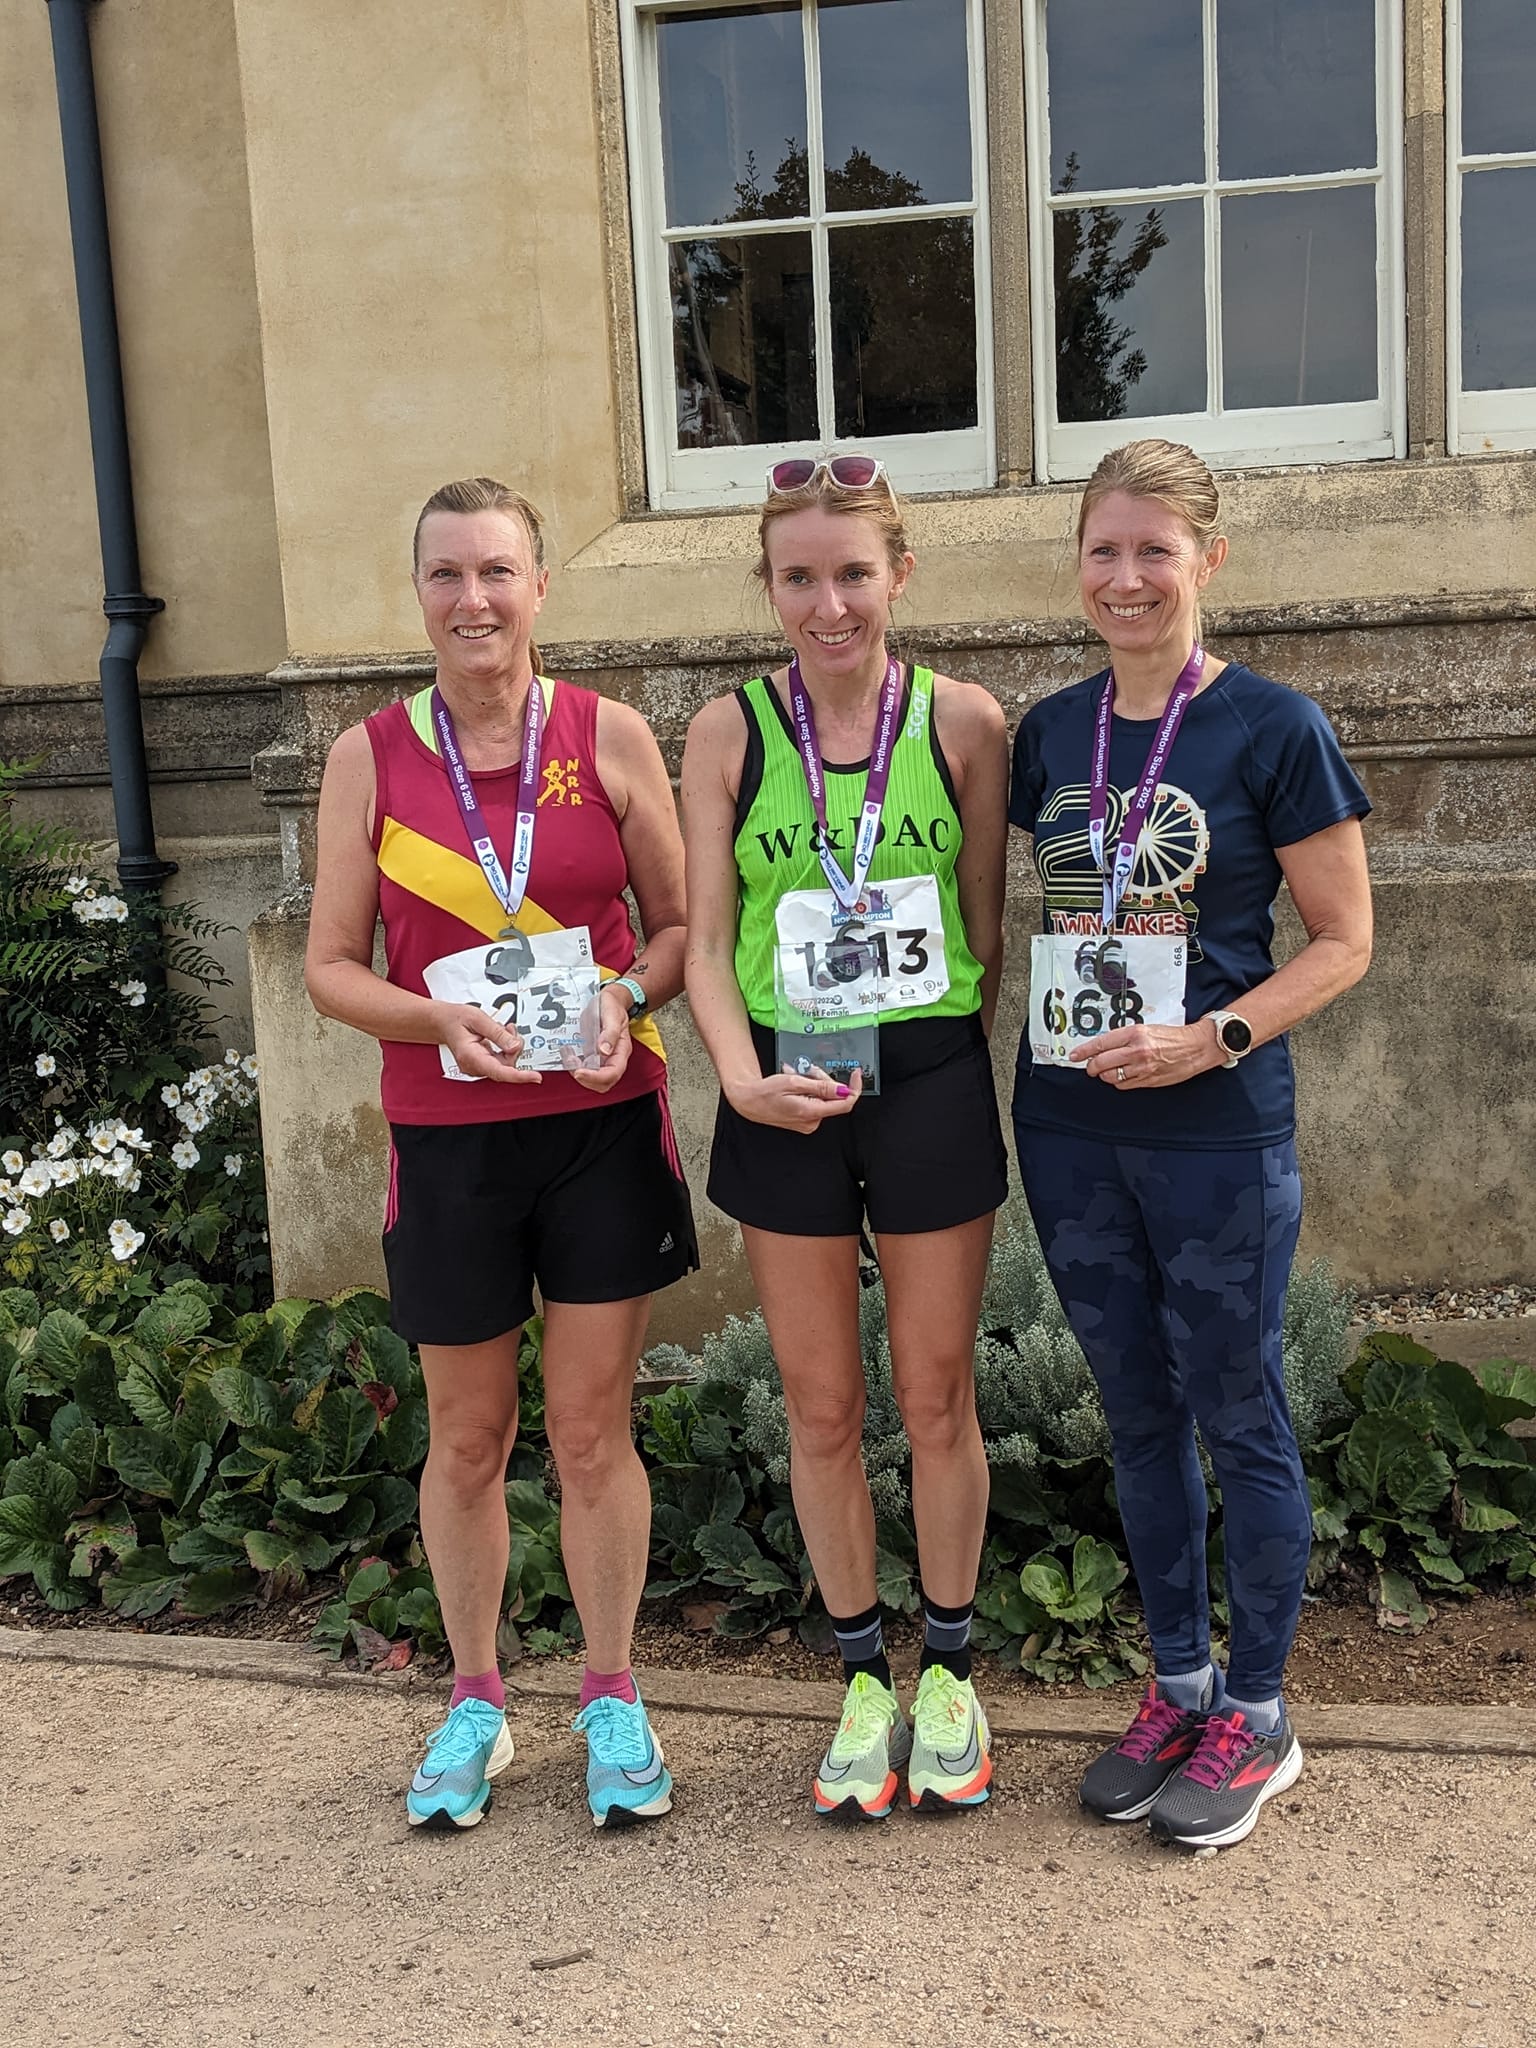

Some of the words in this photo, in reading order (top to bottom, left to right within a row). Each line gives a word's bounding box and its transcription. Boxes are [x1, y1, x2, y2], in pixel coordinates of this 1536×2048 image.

[528, 710, 539, 730] Size
[800, 722, 810, 741] Size
[1157, 691, 1188, 755] Northampton
[873, 713, 892, 772] Northampton
[884, 694, 894, 712] Size
[437, 710, 459, 766] Northampton
[453, 763, 466, 784] Size
[524, 728, 537, 785] Northampton
[1095, 725, 1107, 788] Northampton
[804, 742, 820, 798] Northampton
[1147, 755, 1163, 777] Size
[833, 910, 891, 926] NOHAMPTON
[1051, 912, 1102, 936] TWIN
[1112, 912, 1189, 936] LAKES
[578, 938, 589, 956] 623
[1173, 946, 1183, 967] 668
[801, 1009, 819, 1017] First
[821, 1009, 850, 1017] Female
[1043, 988, 1145, 1037] 668
